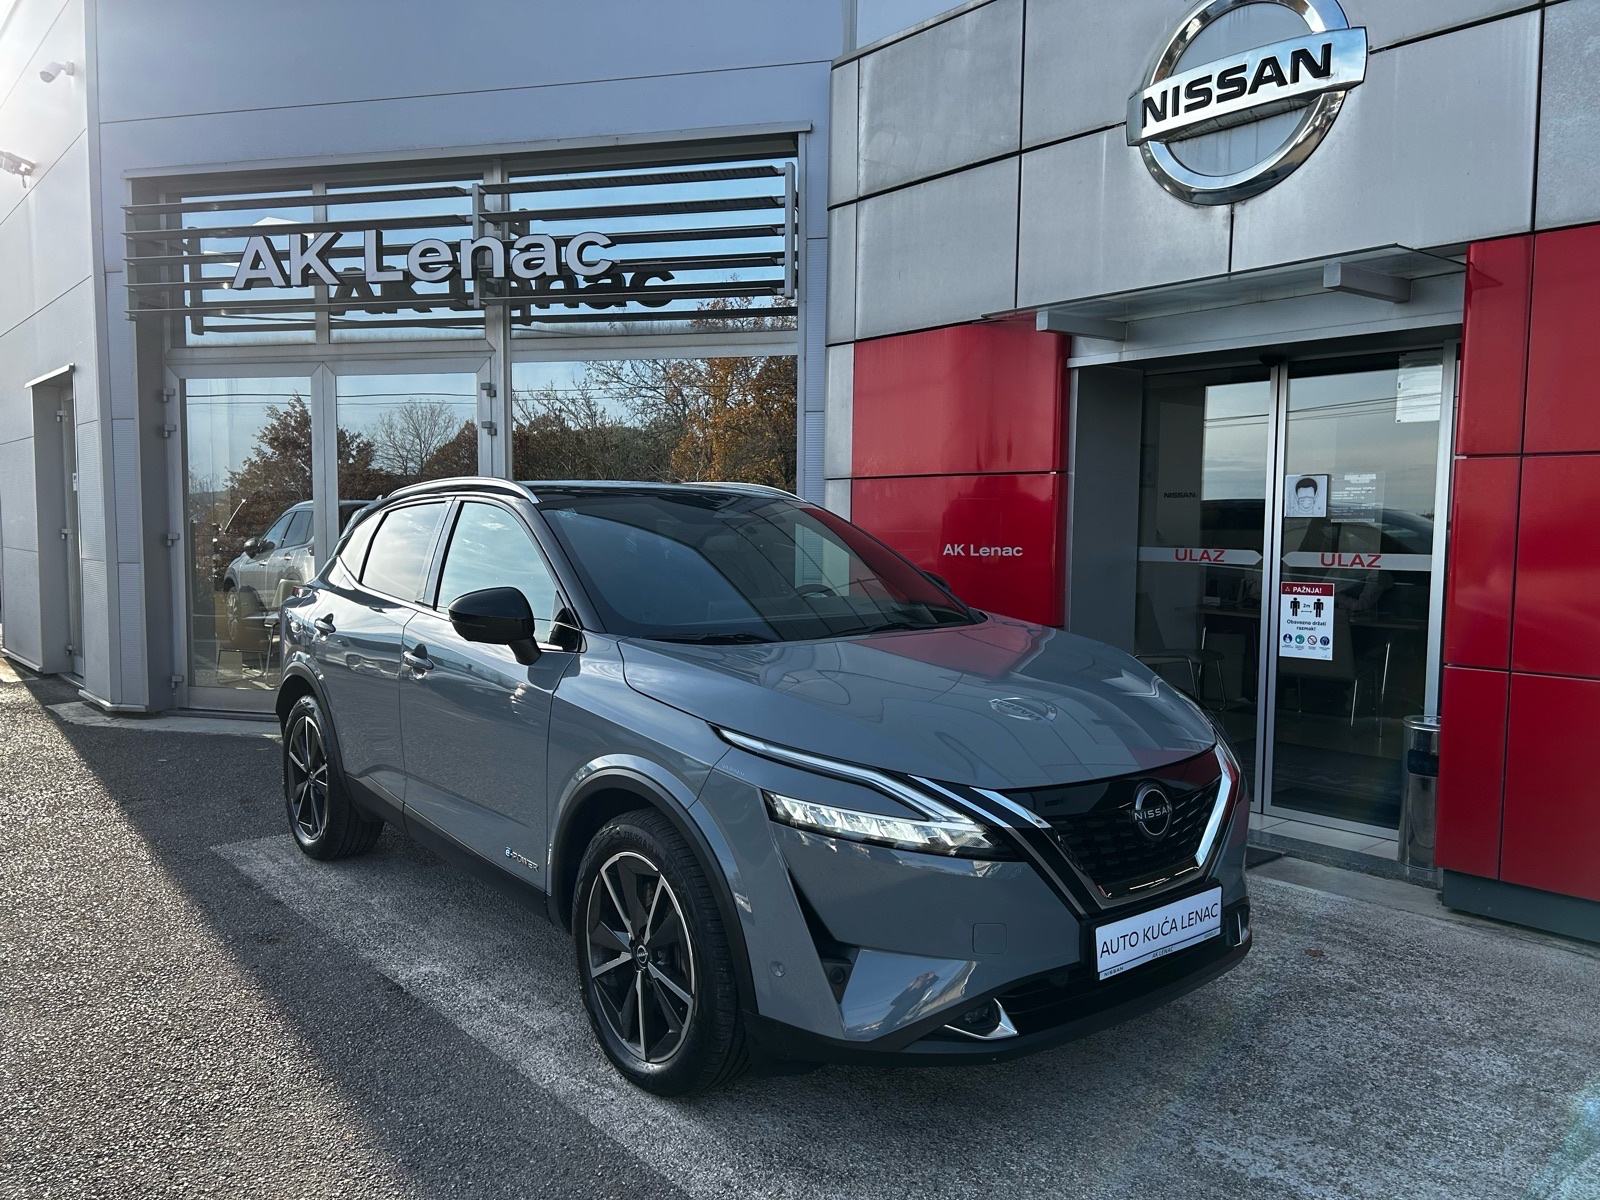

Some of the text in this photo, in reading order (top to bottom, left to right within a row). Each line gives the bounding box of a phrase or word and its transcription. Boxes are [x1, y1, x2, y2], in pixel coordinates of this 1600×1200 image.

[1141, 42, 1333, 129] NISSAN
[232, 229, 618, 289] AK Lenac
[943, 543, 1024, 557] AK Lenac
[1175, 548, 1225, 563] ULAZ
[1320, 552, 1382, 569] ULAZ
[1292, 586, 1322, 594] PAŽNJA!
[1134, 804, 1172, 821] NISSAN
[1100, 903, 1219, 958] AUTO KUĆA LENAC
[1103, 966, 1124, 977] NISSAN
